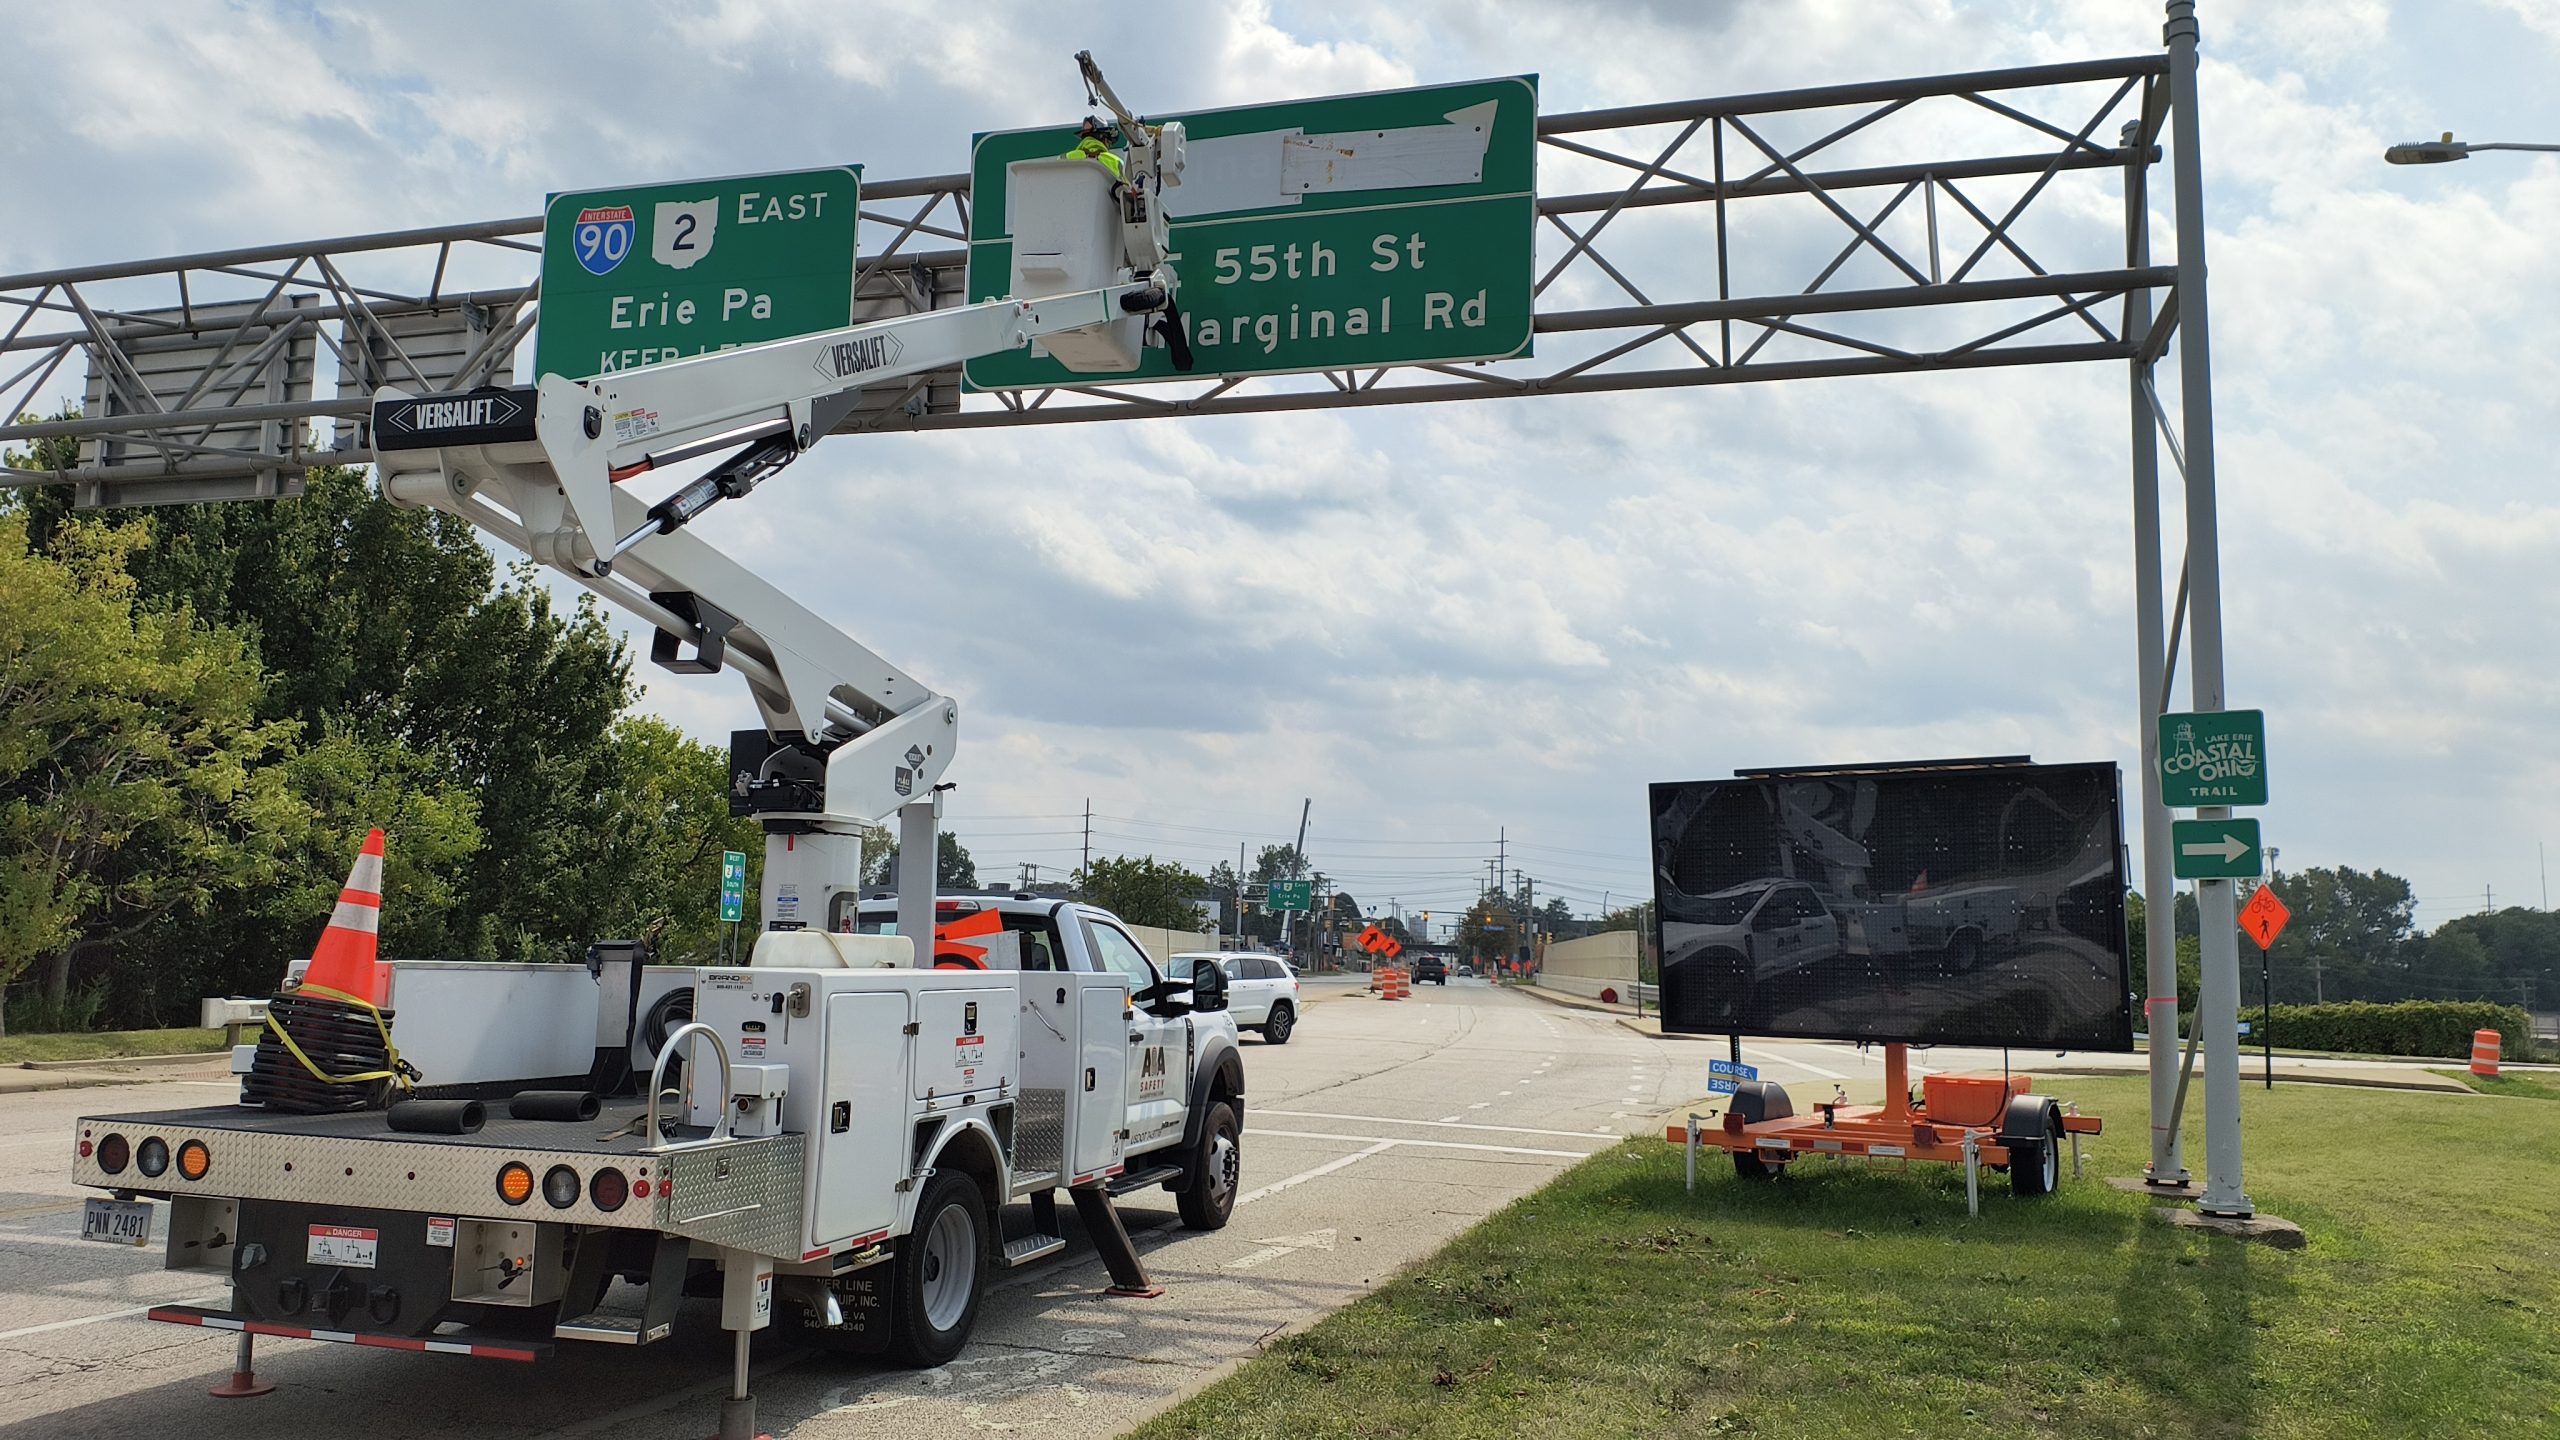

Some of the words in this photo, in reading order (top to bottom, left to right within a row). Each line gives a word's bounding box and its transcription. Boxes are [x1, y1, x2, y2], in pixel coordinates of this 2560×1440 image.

[584, 210, 627, 221] INTERSTATE
[738, 192, 828, 224] EAST
[580, 223, 627, 261] 90
[673, 213, 697, 251] 2
[1214, 240, 1336, 285] 55th
[1370, 232, 1426, 272] St
[611, 291, 696, 329] Erie
[722, 287, 772, 322] Pa
[1424, 288, 1487, 330] Rd
[832, 335, 887, 377] VERSALIFT
[415, 399, 494, 430] VERSALIFT
[2204, 734, 2230, 744] LAKE
[2232, 733, 2254, 742] ERIE
[2163, 742, 2255, 775] COASTAL
[2189, 786, 2238, 797] TRAIL
[1712, 1062, 1749, 1078] COURSE
[1140, 1079, 1165, 1093] SAFETY
[87, 1211, 110, 1235] PNN
[113, 1214, 144, 1238] 2481
[332, 1228, 362, 1238] DANGER
[845, 1279, 874, 1292] LINE
[860, 1295, 881, 1308] INC.
[853, 1311, 866, 1321] VA
